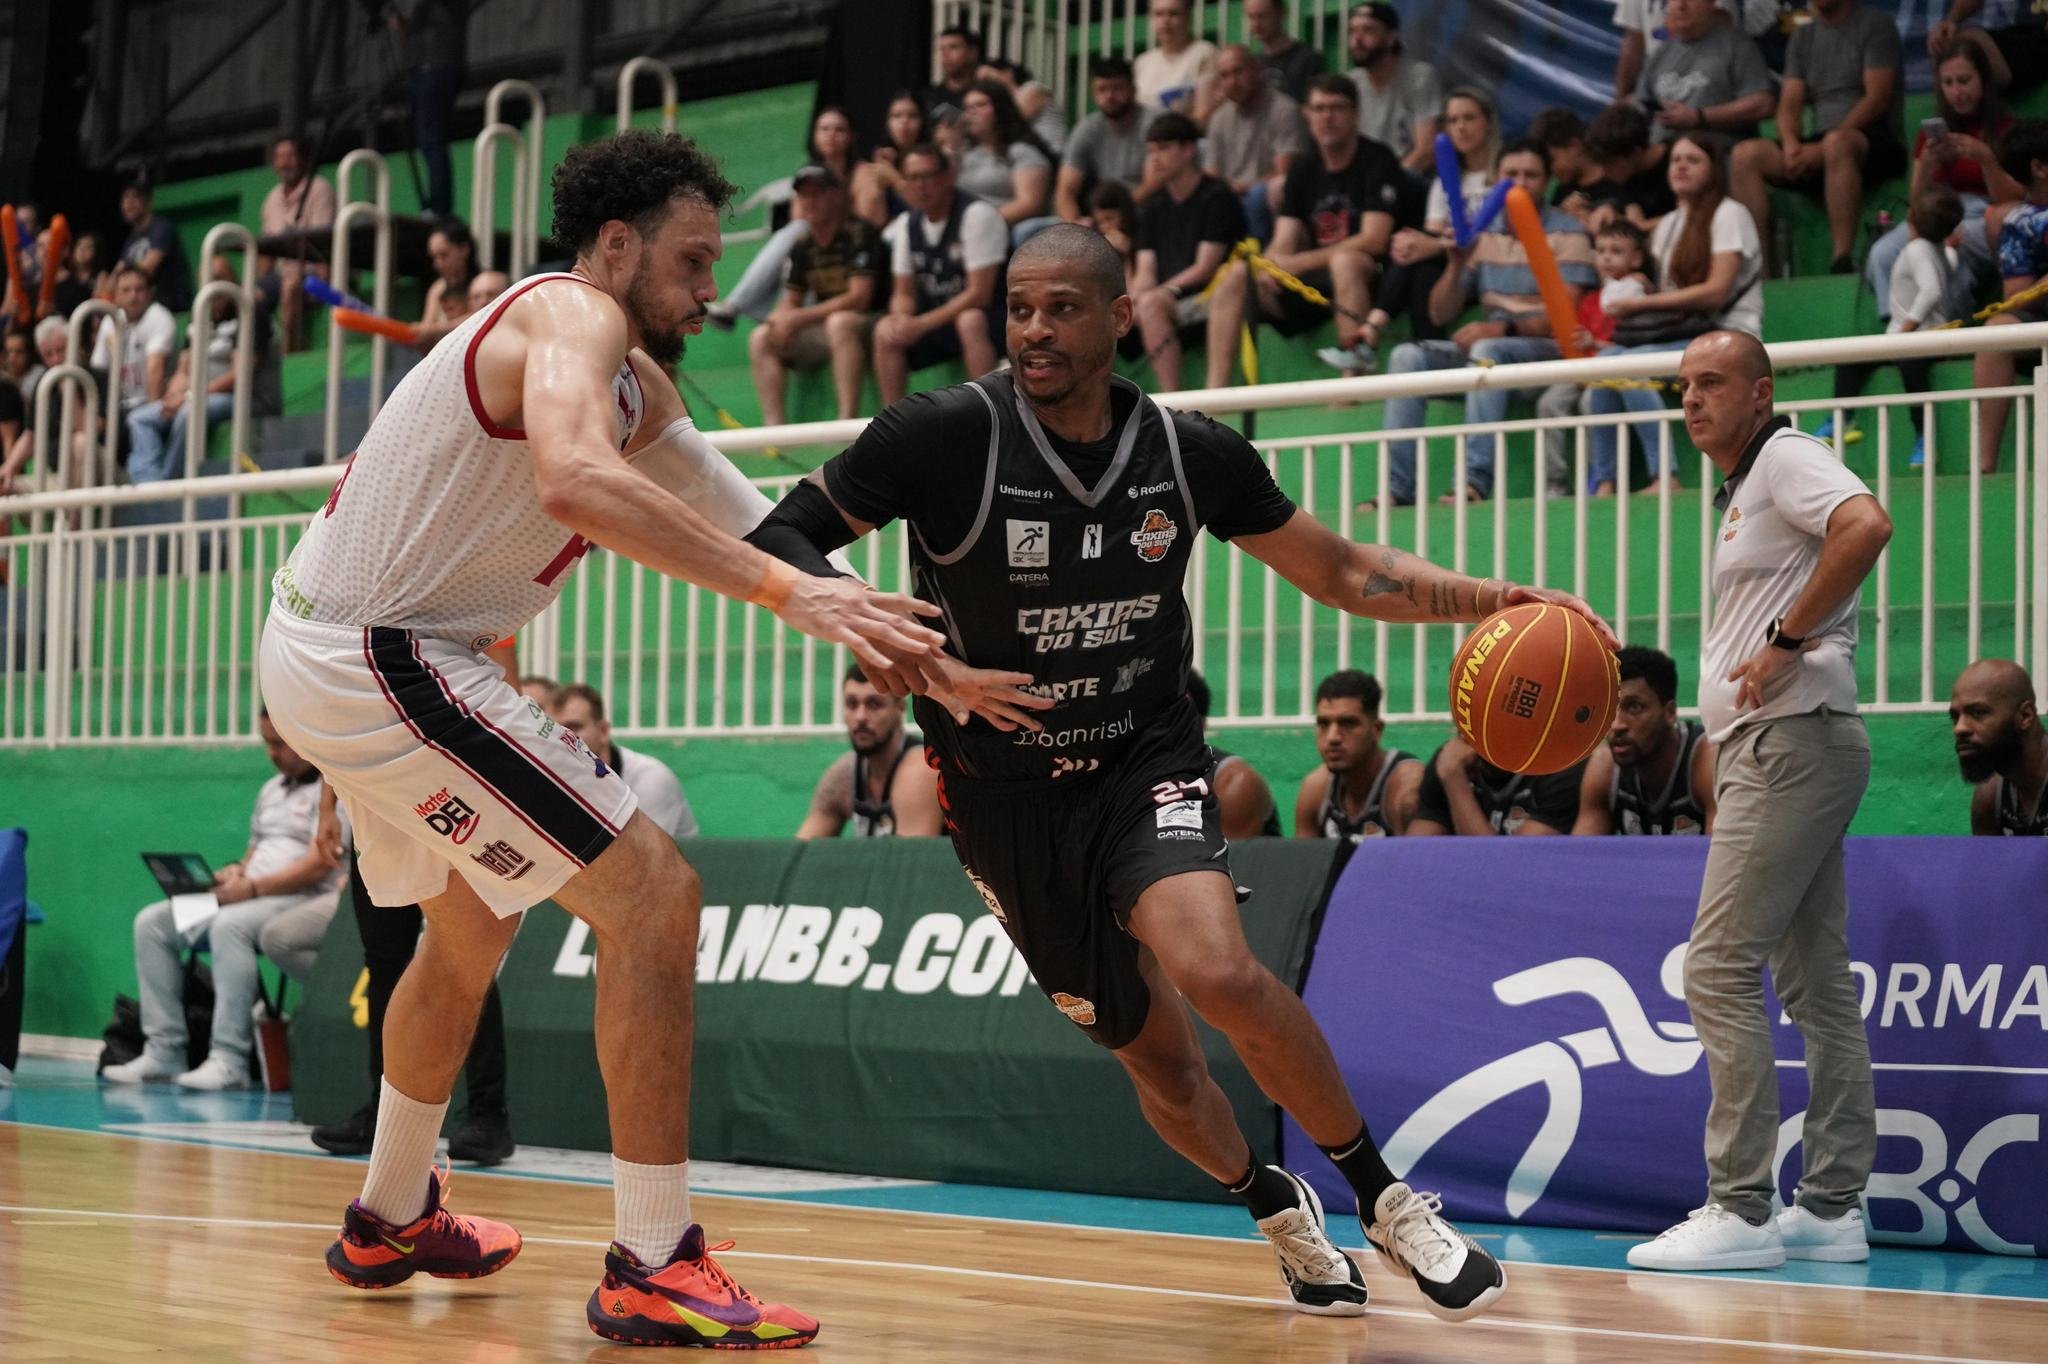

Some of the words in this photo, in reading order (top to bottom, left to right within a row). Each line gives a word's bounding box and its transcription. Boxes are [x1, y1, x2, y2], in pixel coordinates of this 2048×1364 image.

[1000, 484, 1041, 499] Unimed
[1140, 481, 1174, 496] RodOil
[1010, 573, 1049, 581] CATERA
[1018, 594, 1161, 634] CAXIAS
[1036, 632, 1074, 653] DO
[1082, 623, 1135, 648] SUL
[1456, 619, 1512, 741] PENALTY
[1515, 680, 1542, 719] FIBA
[1038, 710, 1134, 747] banrisul
[413, 787, 451, 818] Mater
[425, 796, 475, 836] DEI
[1157, 829, 1205, 839] CATERA
[553, 904, 1039, 996] LANBB.CO
